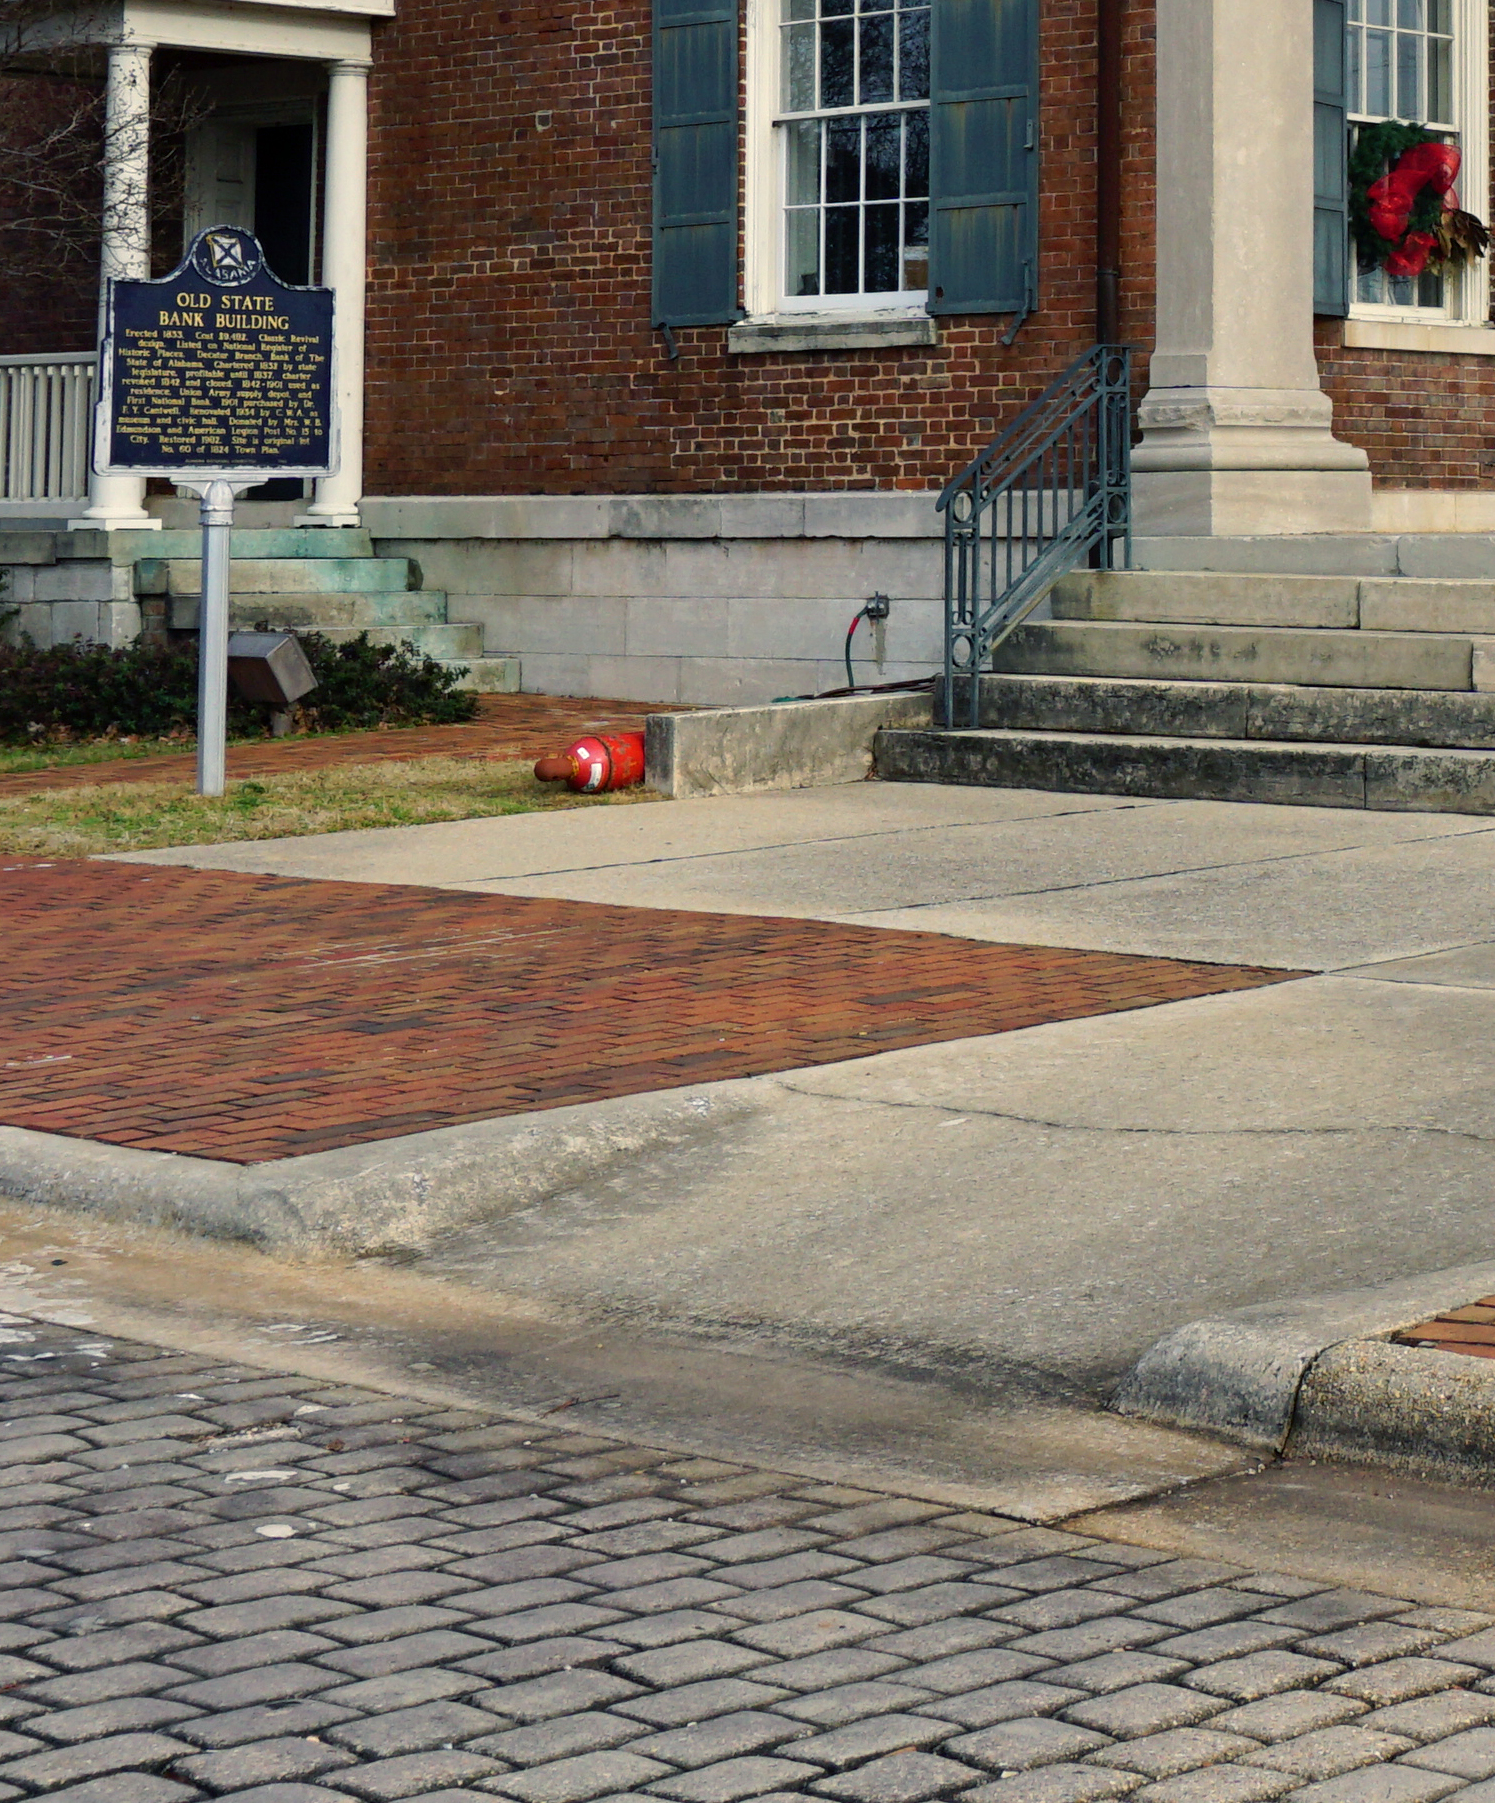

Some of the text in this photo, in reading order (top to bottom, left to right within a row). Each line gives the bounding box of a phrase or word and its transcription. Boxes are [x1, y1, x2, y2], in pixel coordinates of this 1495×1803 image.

[176, 292, 274, 311] OLD STATE
[159, 311, 289, 330] BANK BUILDING
[125, 329, 158, 338] Erected
[195, 331, 213, 340] Cost
[259, 334, 286, 342] Classic
[291, 335, 319, 343] Revival
[177, 340, 201, 349] Listed
[223, 342, 255, 351] National
[261, 344, 292, 352] Register
[299, 344, 307, 352] of
[119, 348, 150, 356] Historic
[197, 350, 228, 359] Decatur
[271, 353, 289, 361] Bank
[309, 354, 324, 362] The
[126, 358, 147, 366] State
[153, 359, 162, 367] of
[214, 361, 254, 369] Chartered
[283, 363, 293, 371] by
[186, 370, 224, 378] profitable
[180, 388, 202, 396] Union
[209, 389, 231, 397] Army
[236, 390, 262, 398] supply
[127, 396, 145, 404] First
[152, 397, 185, 405] National
[190, 407, 230, 415] Renovated
[260, 409, 270, 417] by
[229, 417, 262, 425] Donated
[268, 418, 278, 426] by
[116, 425, 161, 433] Edmundson
[188, 426, 226, 434] American
[232, 427, 258, 436] Legion
[264, 427, 280, 435] Post
[159, 435, 195, 443] Restored
[232, 436, 247, 444] Site
[264, 438, 294, 447] original
[235, 446, 256, 454] Town
